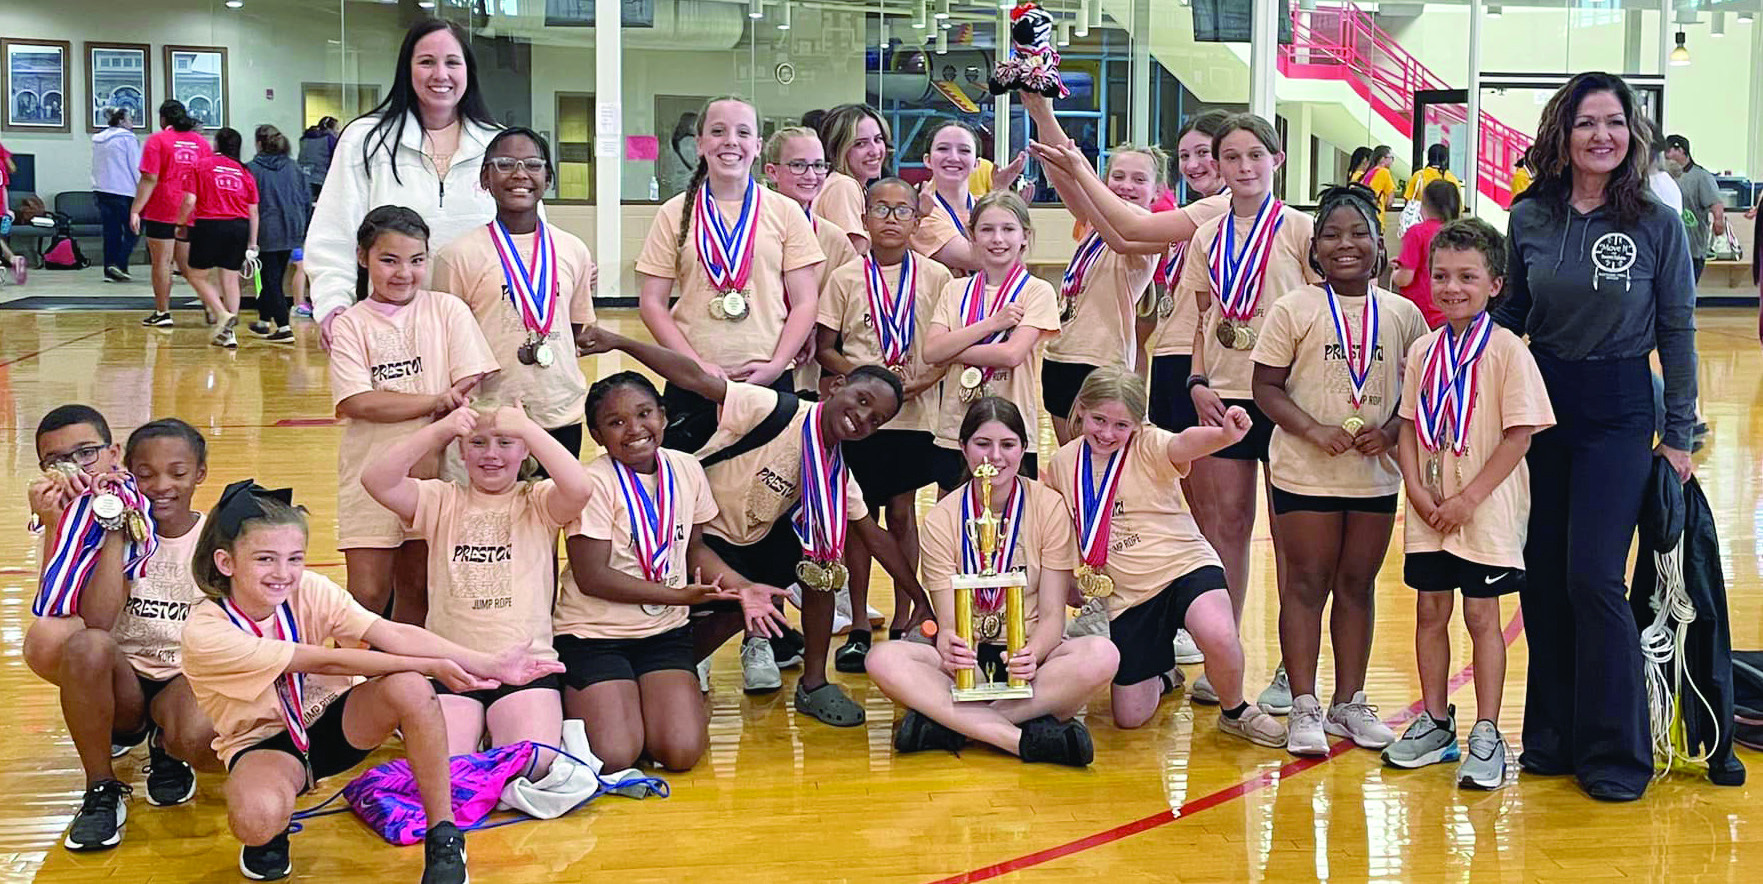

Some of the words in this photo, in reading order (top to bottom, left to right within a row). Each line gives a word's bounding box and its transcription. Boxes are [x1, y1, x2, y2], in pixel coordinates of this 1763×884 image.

[123, 596, 192, 621] PRESTON
[471, 598, 493, 611] JUMP
[494, 597, 512, 610] ROPE
[303, 704, 321, 725] UMP
